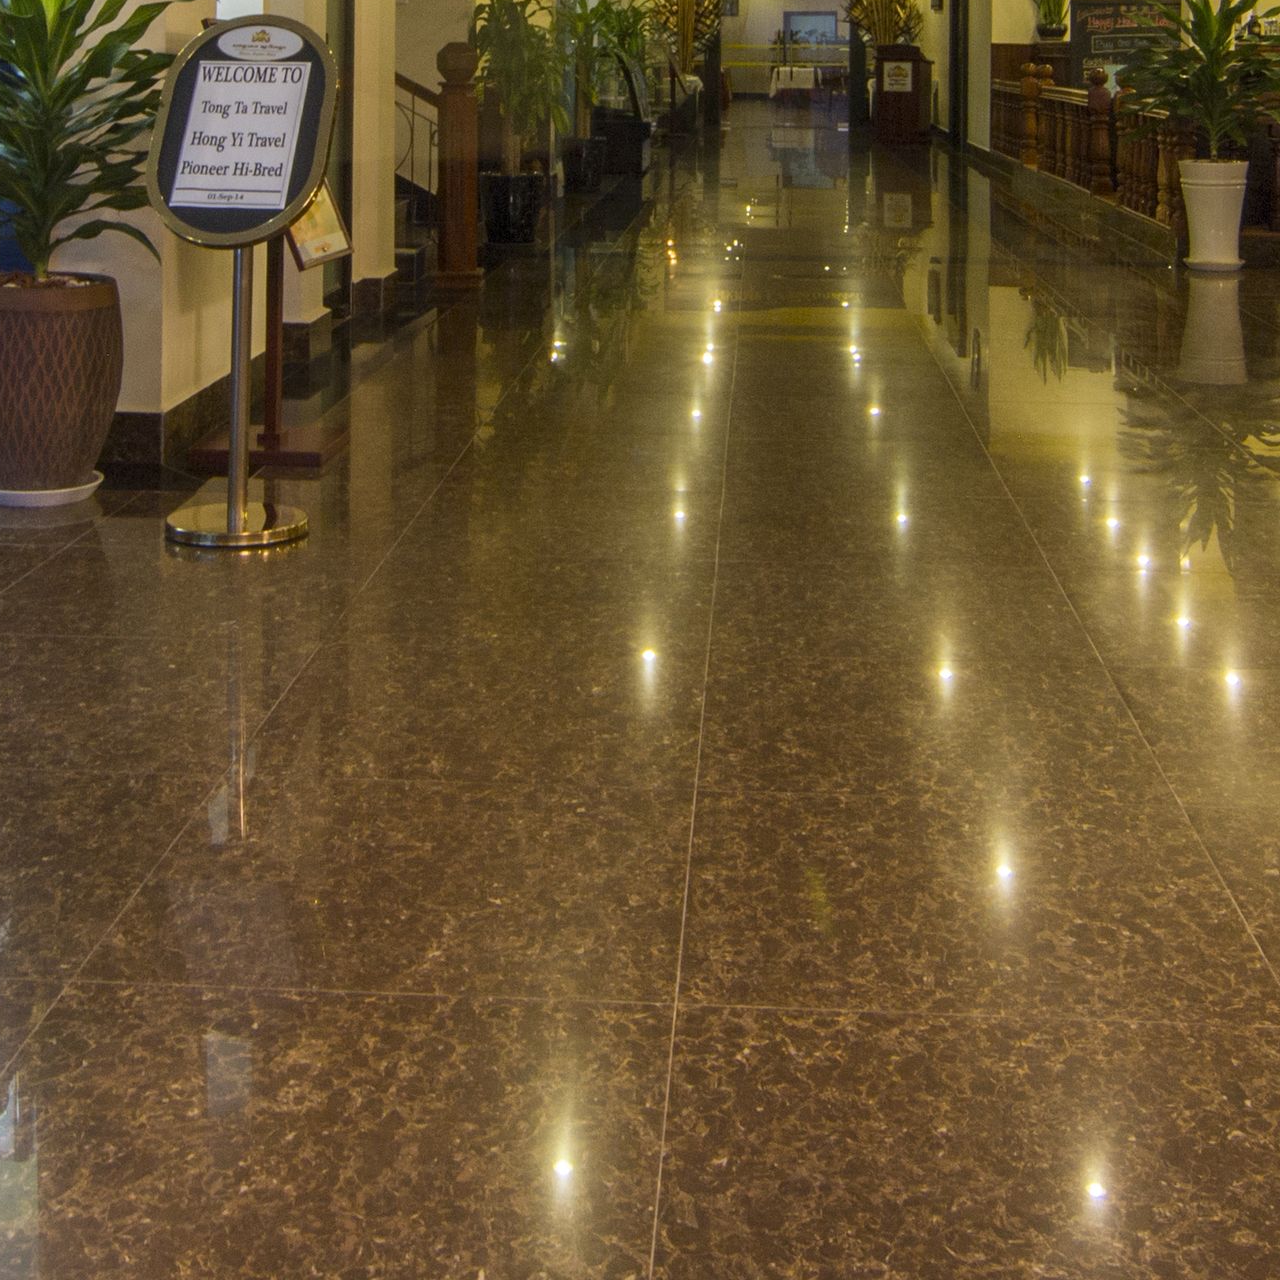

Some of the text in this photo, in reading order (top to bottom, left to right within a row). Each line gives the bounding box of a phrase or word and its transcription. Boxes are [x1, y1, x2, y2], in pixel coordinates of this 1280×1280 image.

[202, 65, 303, 84] WELCOME TO
[202, 100, 288, 119] Tong Ta Travel
[190, 130, 286, 152] Hong Yi Travel
[180, 160, 284, 177] Pioneer Hi-Bred
